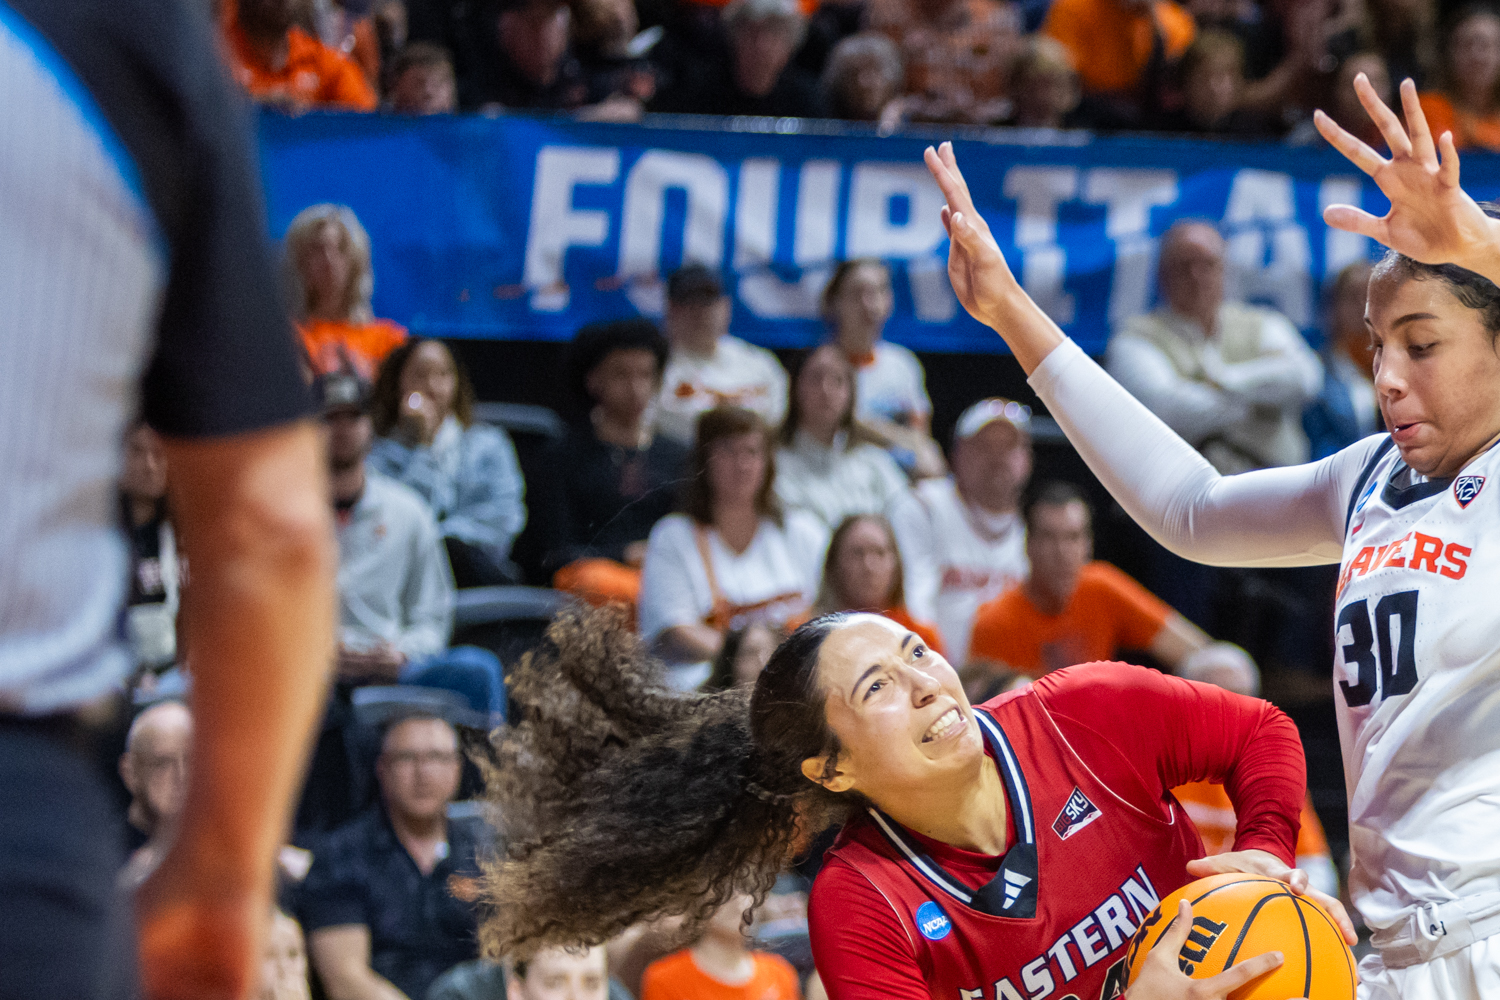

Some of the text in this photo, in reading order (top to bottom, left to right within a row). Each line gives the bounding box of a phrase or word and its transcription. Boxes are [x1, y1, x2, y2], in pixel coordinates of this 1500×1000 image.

[522, 144, 958, 326] FOUR
[1456, 476, 1484, 494] PAC
[1458, 488, 1473, 501] 12
[1335, 589, 1420, 708] 30
[1054, 813, 1072, 832] BIG
